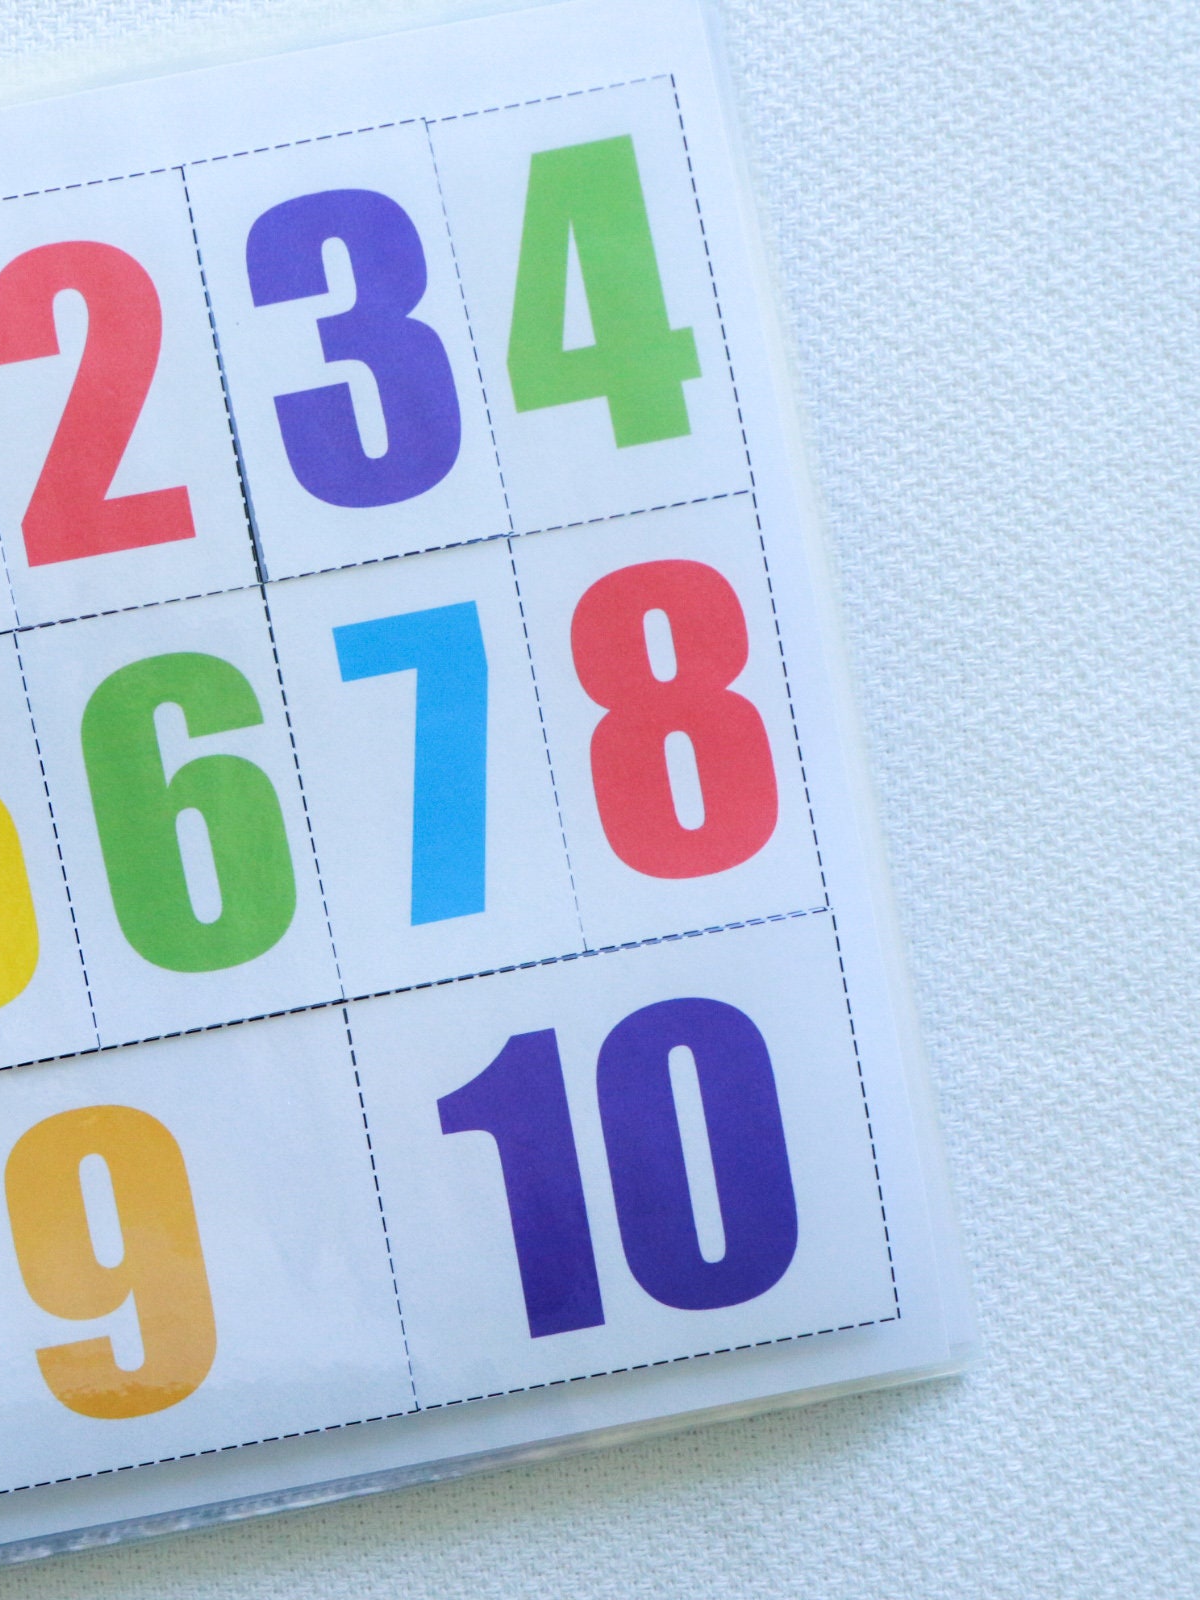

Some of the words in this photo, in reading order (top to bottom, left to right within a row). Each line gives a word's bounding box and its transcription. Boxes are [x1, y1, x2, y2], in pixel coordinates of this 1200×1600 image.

[245, 188, 464, 509] 3
[506, 133, 702, 449] 4
[81, 653, 295, 972] 6
[331, 599, 490, 927] 7
[570, 558, 780, 880] 8
[4, 1104, 219, 1420] 9
[437, 996, 800, 1340] 10
